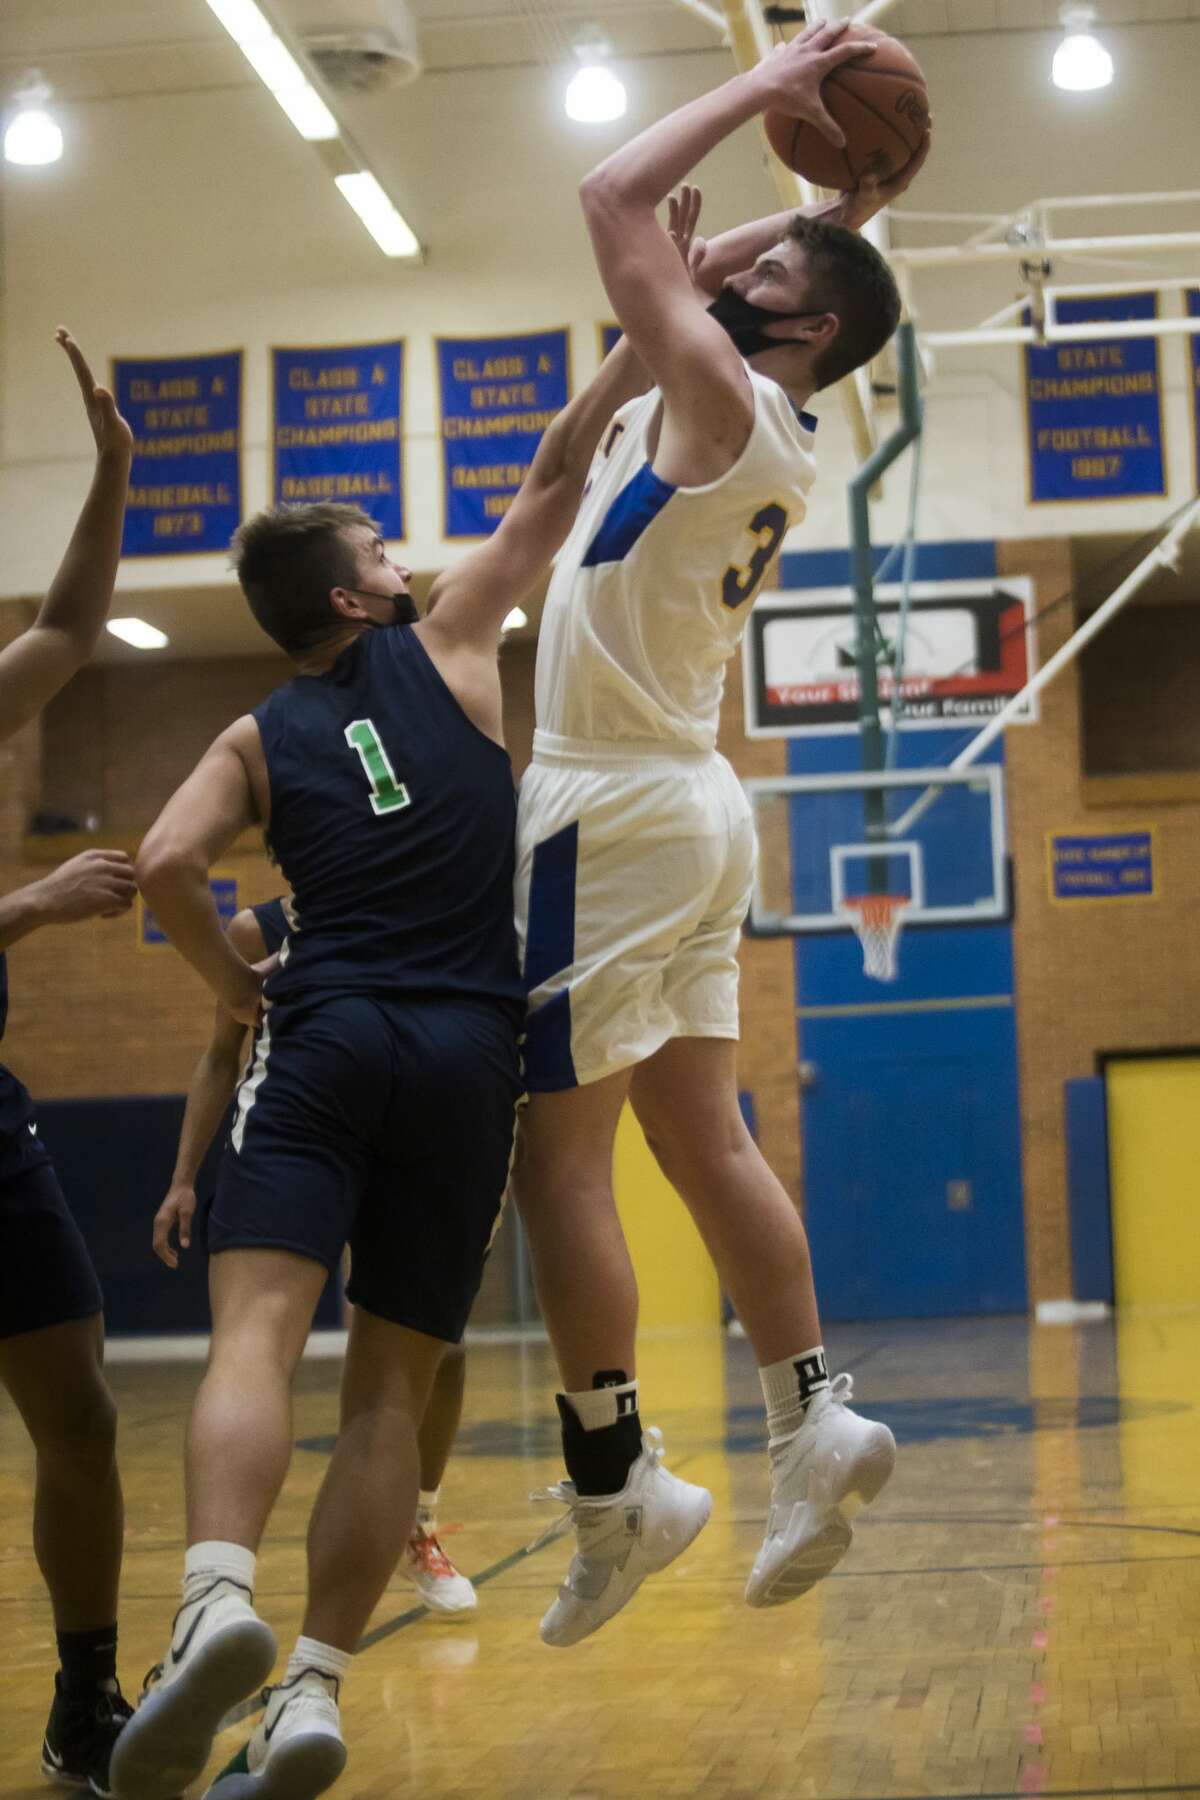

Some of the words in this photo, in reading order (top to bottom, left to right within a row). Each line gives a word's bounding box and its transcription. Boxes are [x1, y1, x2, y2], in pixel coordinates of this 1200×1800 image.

[454, 356, 524, 381] CLASS
[1057, 345, 1123, 370] STATE
[289, 367, 358, 390] CLASS
[1029, 371, 1154, 399] CHAMPIONS
[305, 392, 369, 419] STATE
[471, 383, 536, 408] STATE
[145, 405, 209, 429] STATE
[132, 429, 236, 456] HAMPIONS
[276, 418, 397, 447] CHAMPIONS
[1037, 423, 1151, 451] FOOTBALL
[282, 471, 391, 497] BASEBALL
[720, 502, 789, 611] 3
[343, 718, 412, 815] 1
